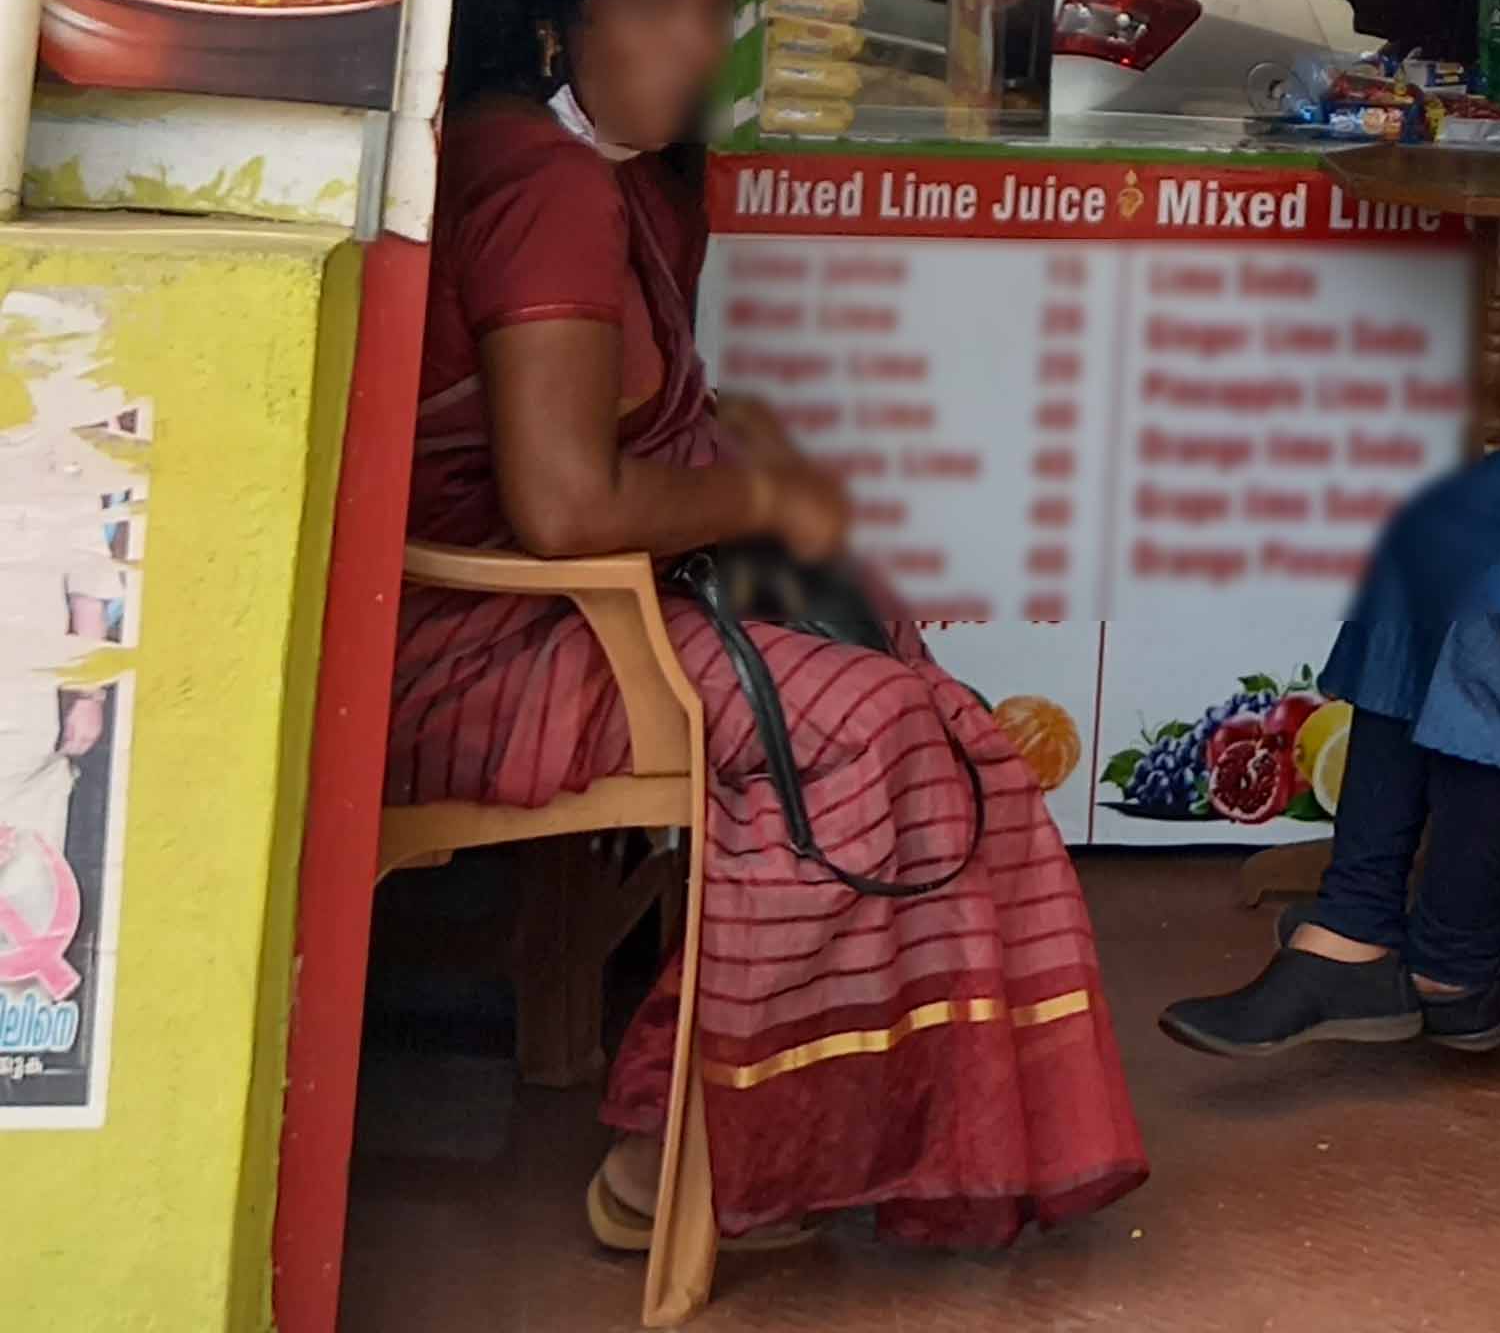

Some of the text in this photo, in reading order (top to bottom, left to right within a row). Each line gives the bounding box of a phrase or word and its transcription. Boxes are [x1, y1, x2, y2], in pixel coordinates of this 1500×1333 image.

[735, 167, 1107, 223] Mixed Lime Juice
[1156, 178, 1309, 231] Mixed
